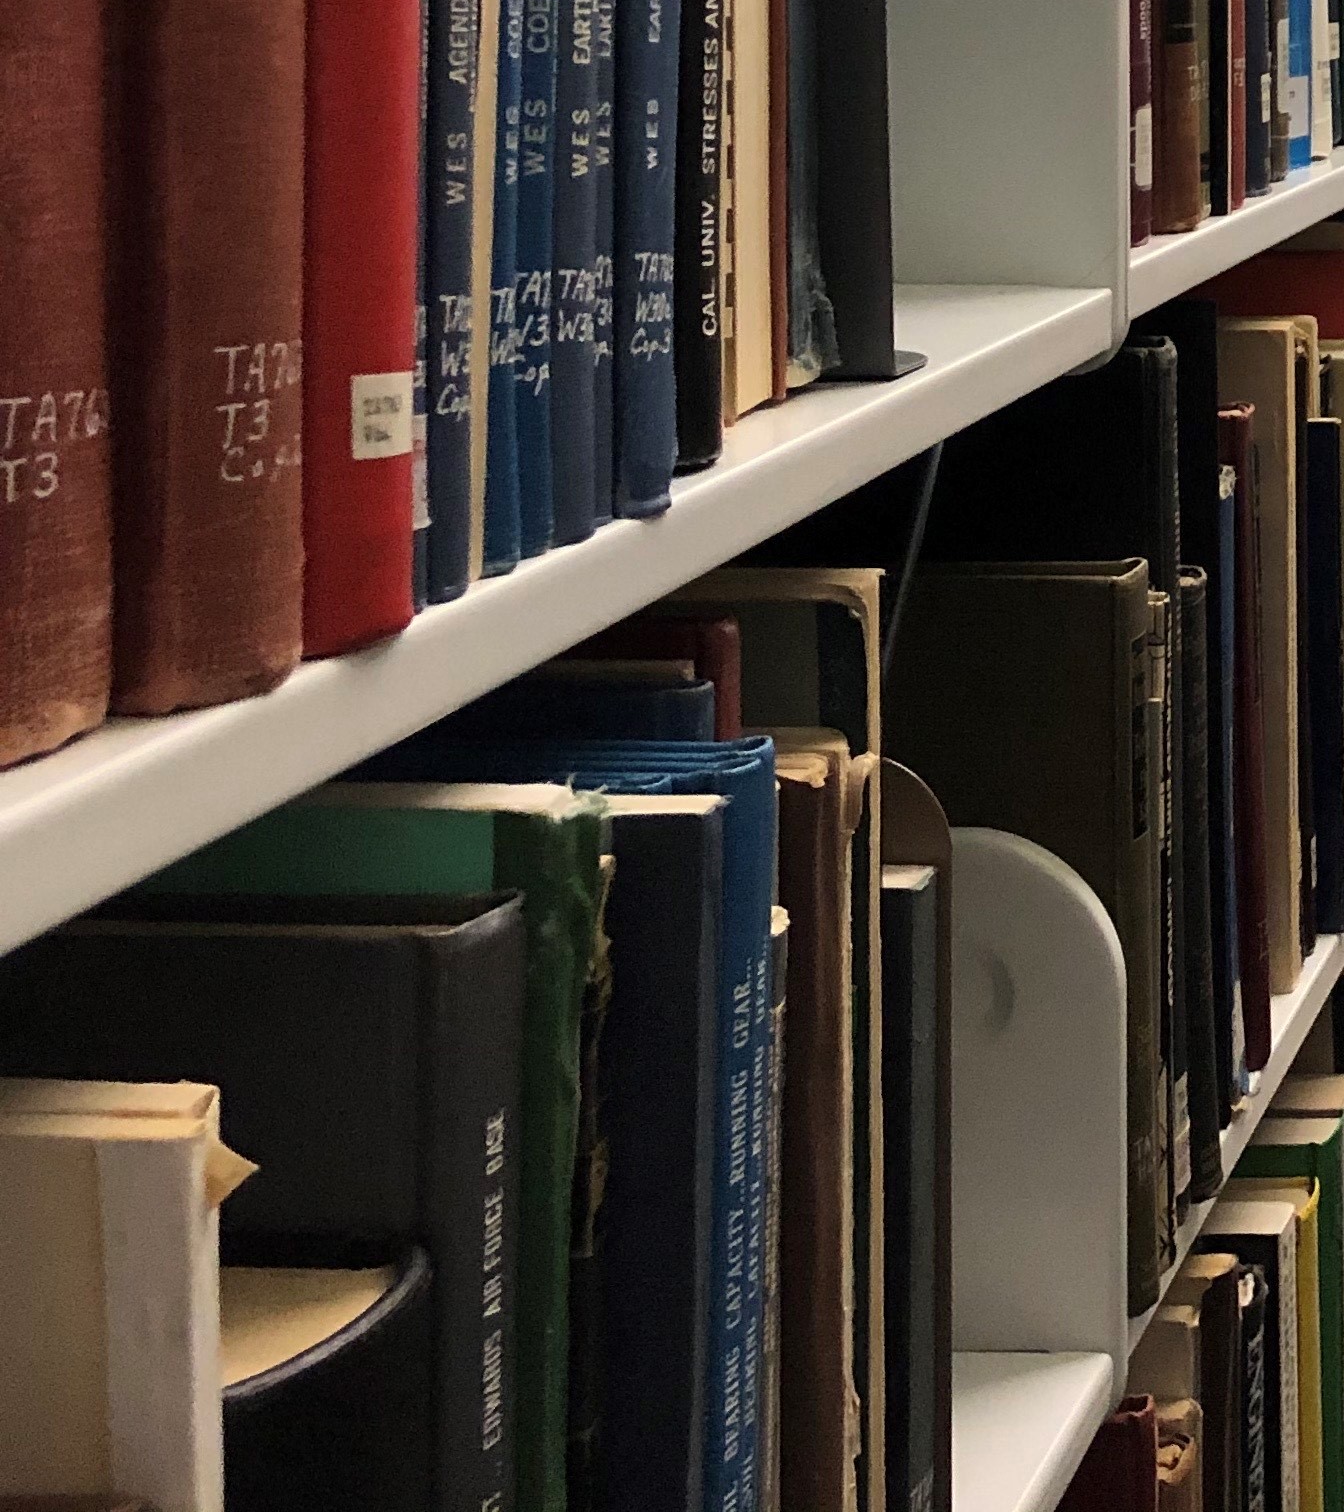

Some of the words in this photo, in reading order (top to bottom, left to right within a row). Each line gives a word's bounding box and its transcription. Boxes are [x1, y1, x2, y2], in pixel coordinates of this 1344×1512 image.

[702, 39, 718, 174] STRESSES
[485, 1106, 505, 1176] BASE
[483, 1188, 504, 1272] FORCE
[481, 1275, 502, 1318] AIR
[481, 1329, 502, 1451] EDWARDS
[723, 1346, 741, 1463] BEARING
